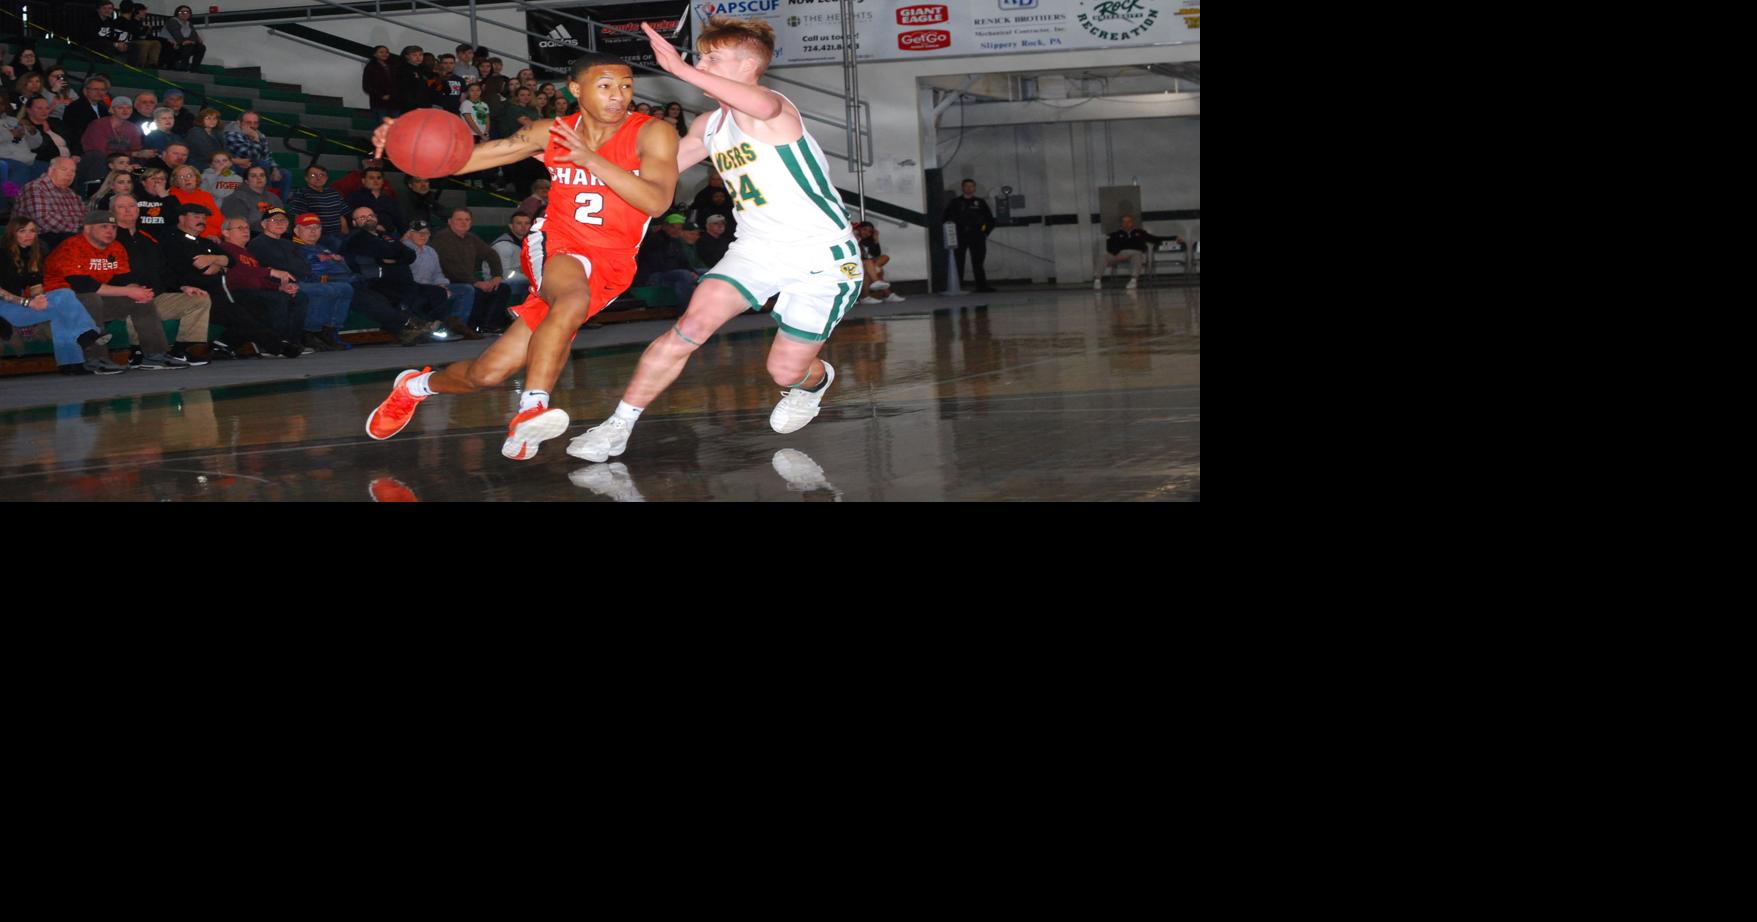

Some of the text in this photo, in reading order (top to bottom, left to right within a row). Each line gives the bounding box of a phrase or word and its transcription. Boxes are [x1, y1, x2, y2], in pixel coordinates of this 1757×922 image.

[716, 1, 779, 13] APSCUF
[900, 7, 943, 16] GIANT
[902, 14, 943, 23] EAGLE
[1077, 9, 1158, 40] RECREATION
[539, 38, 578, 48] adidas
[902, 32, 946, 44] GetGo
[1049, 37, 1062, 45] PA
[575, 192, 604, 226] 2
